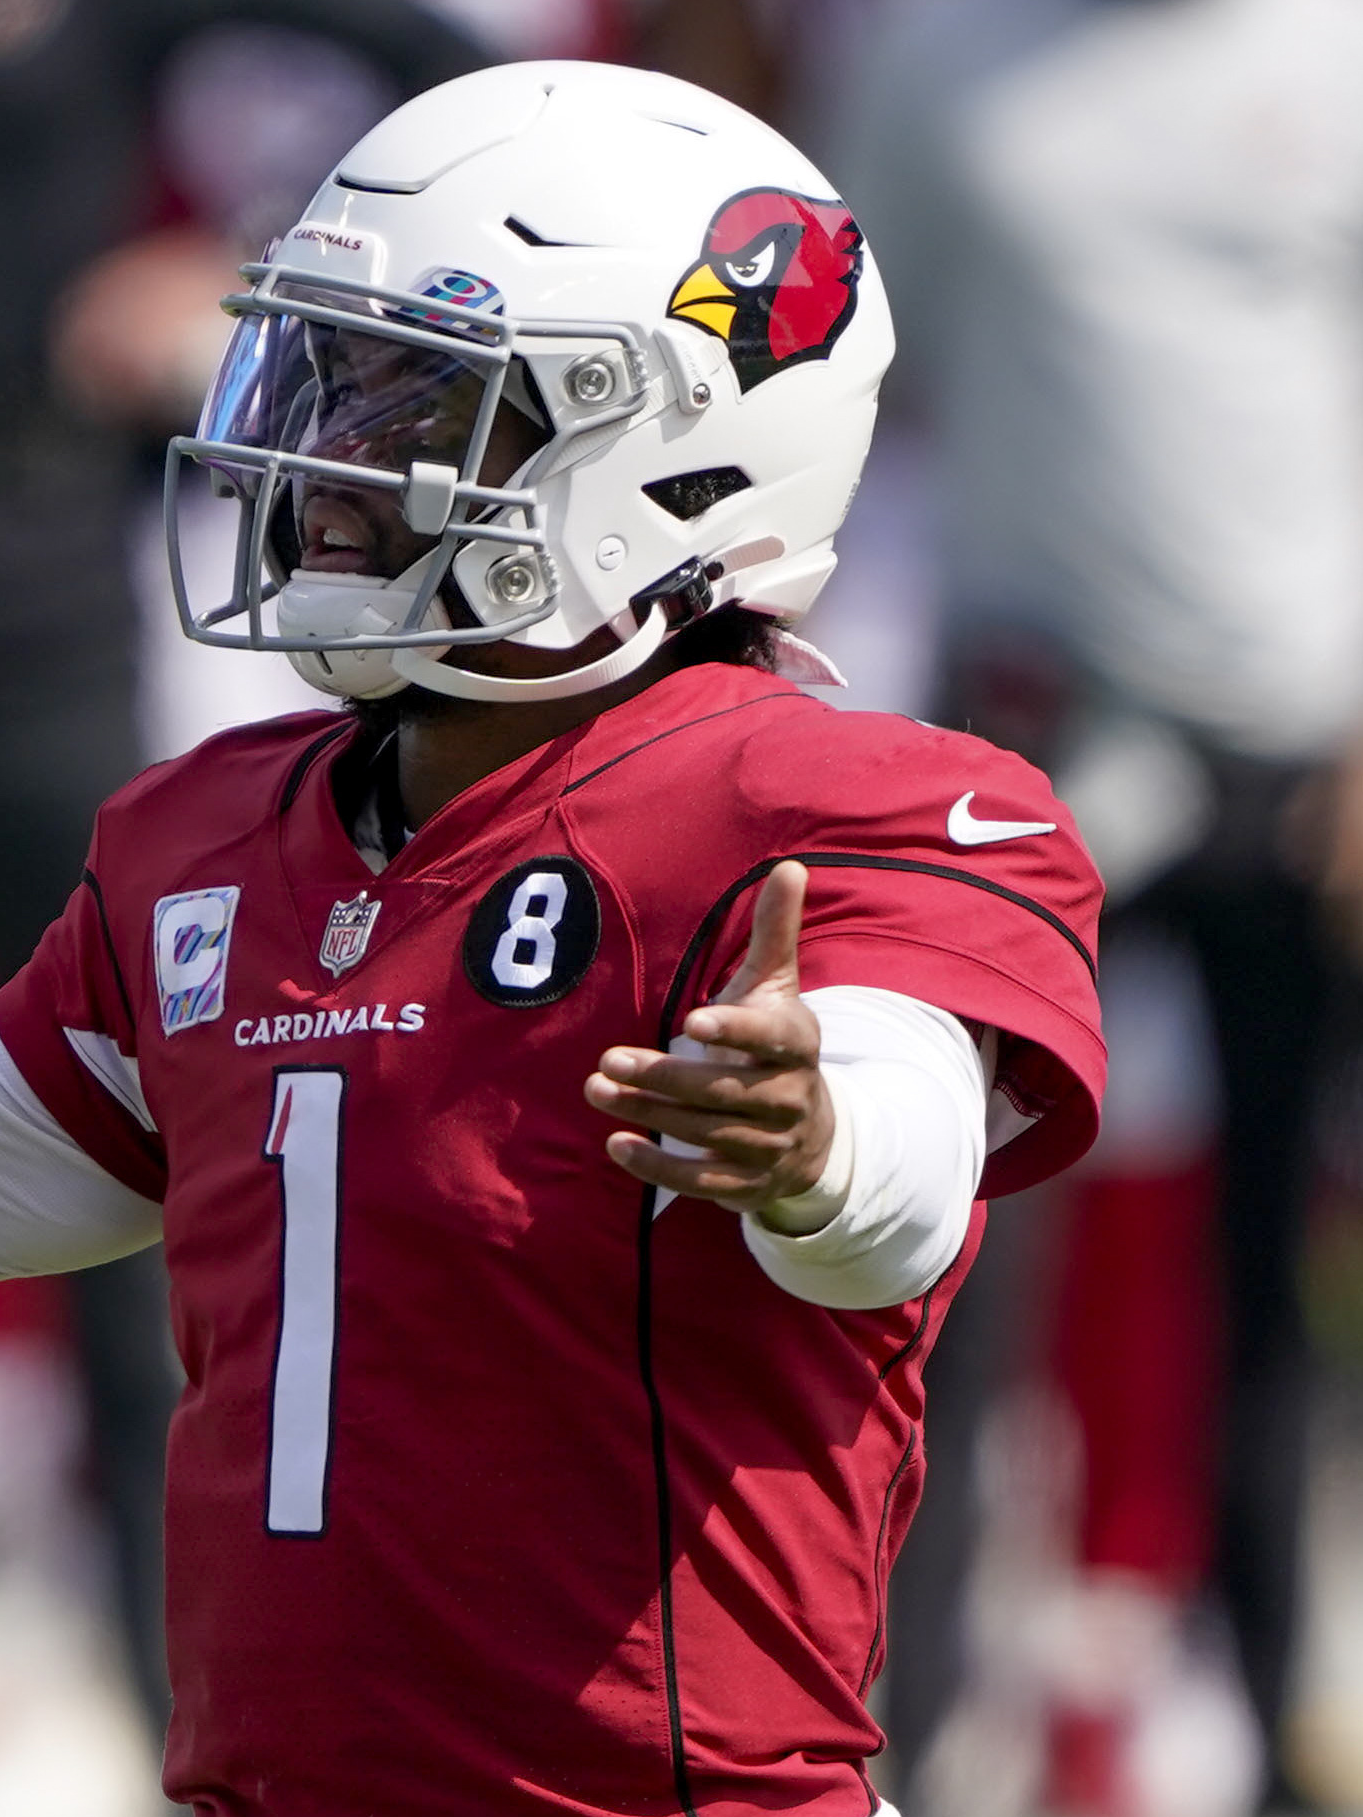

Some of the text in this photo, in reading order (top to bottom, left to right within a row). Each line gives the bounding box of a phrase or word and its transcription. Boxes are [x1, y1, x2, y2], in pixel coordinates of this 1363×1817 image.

[294, 229, 362, 250] CARDINALS
[163, 896, 226, 994] C
[326, 929, 358, 960] NFL
[491, 872, 568, 989] 8
[234, 1003, 426, 1047] CARDINALS
[262, 1064, 349, 1540] 1
